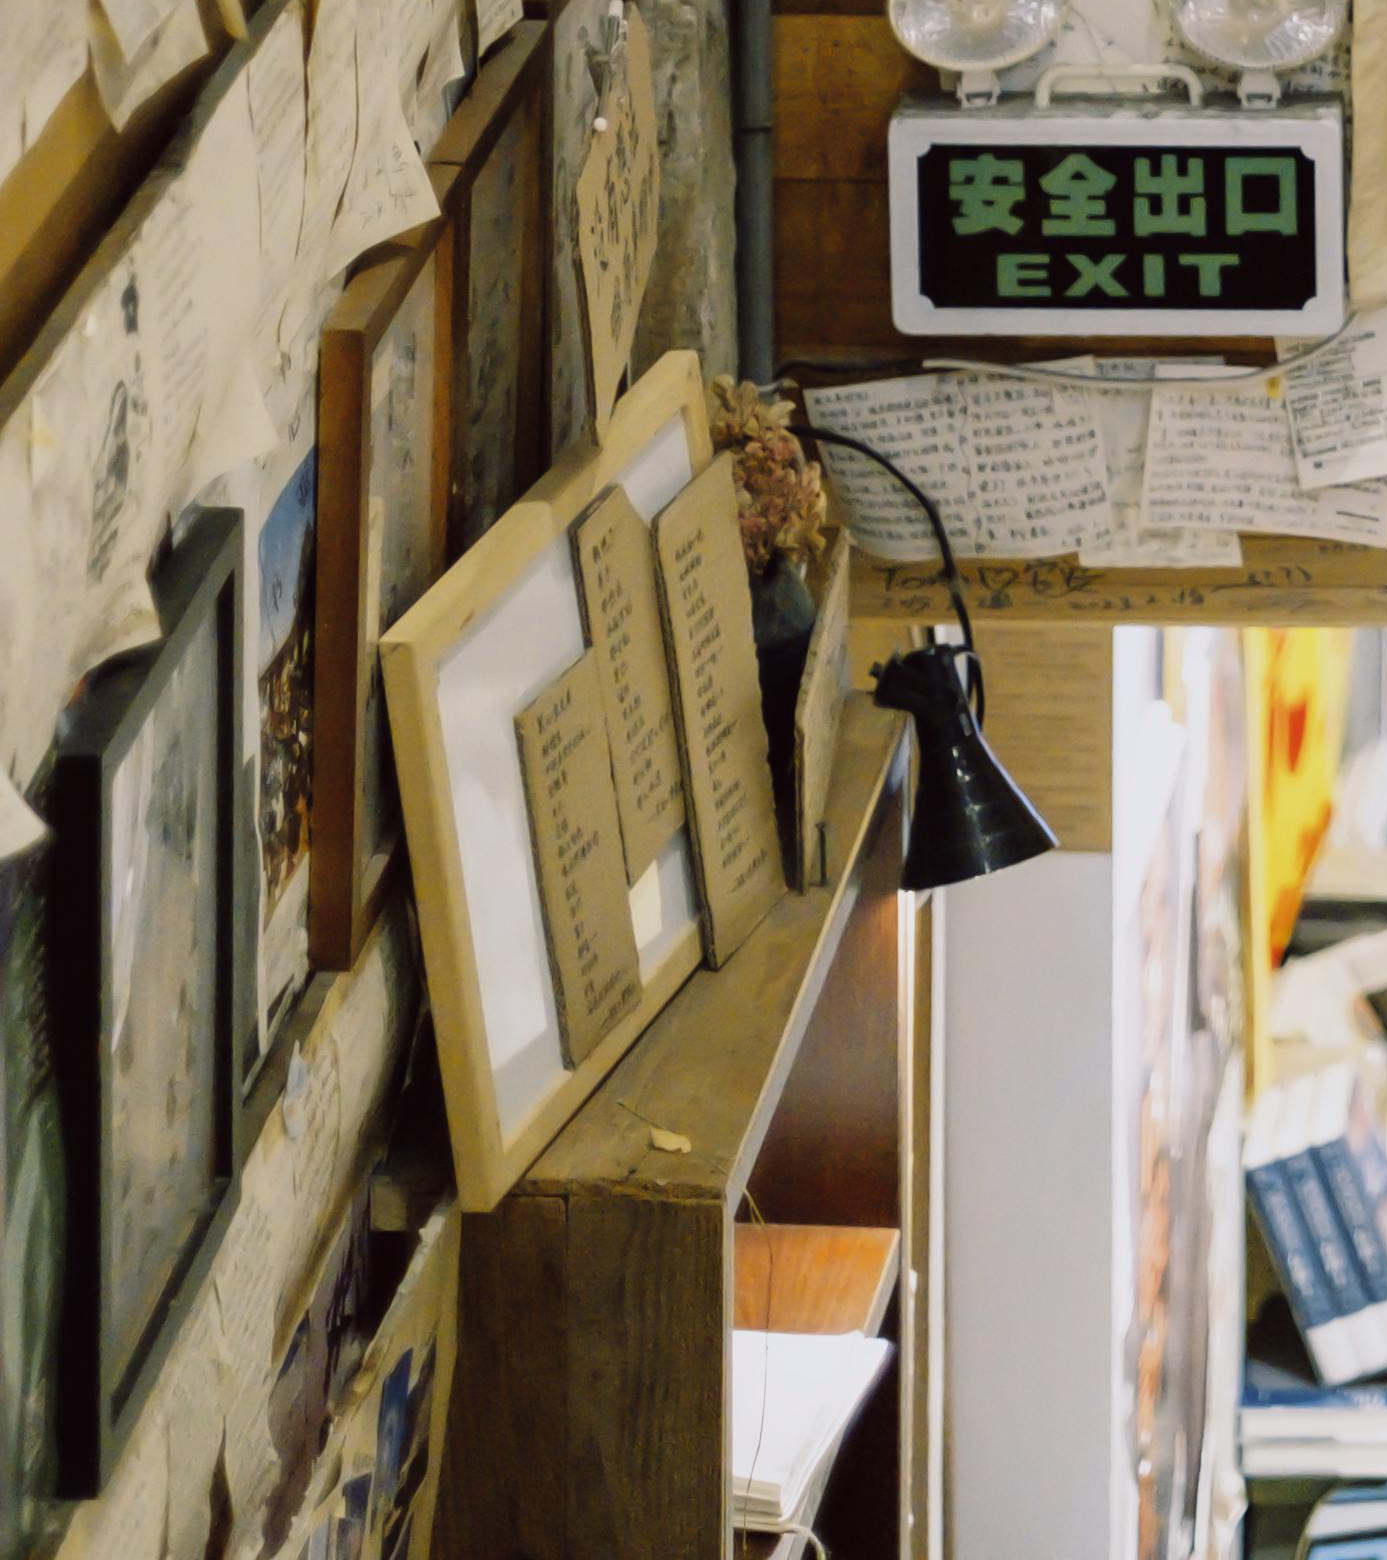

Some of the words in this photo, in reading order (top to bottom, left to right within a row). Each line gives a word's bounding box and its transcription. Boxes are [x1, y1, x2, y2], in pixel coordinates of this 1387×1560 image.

[948, 154, 1297, 237] 安全出口
[997, 254, 1240, 298] EXIT
